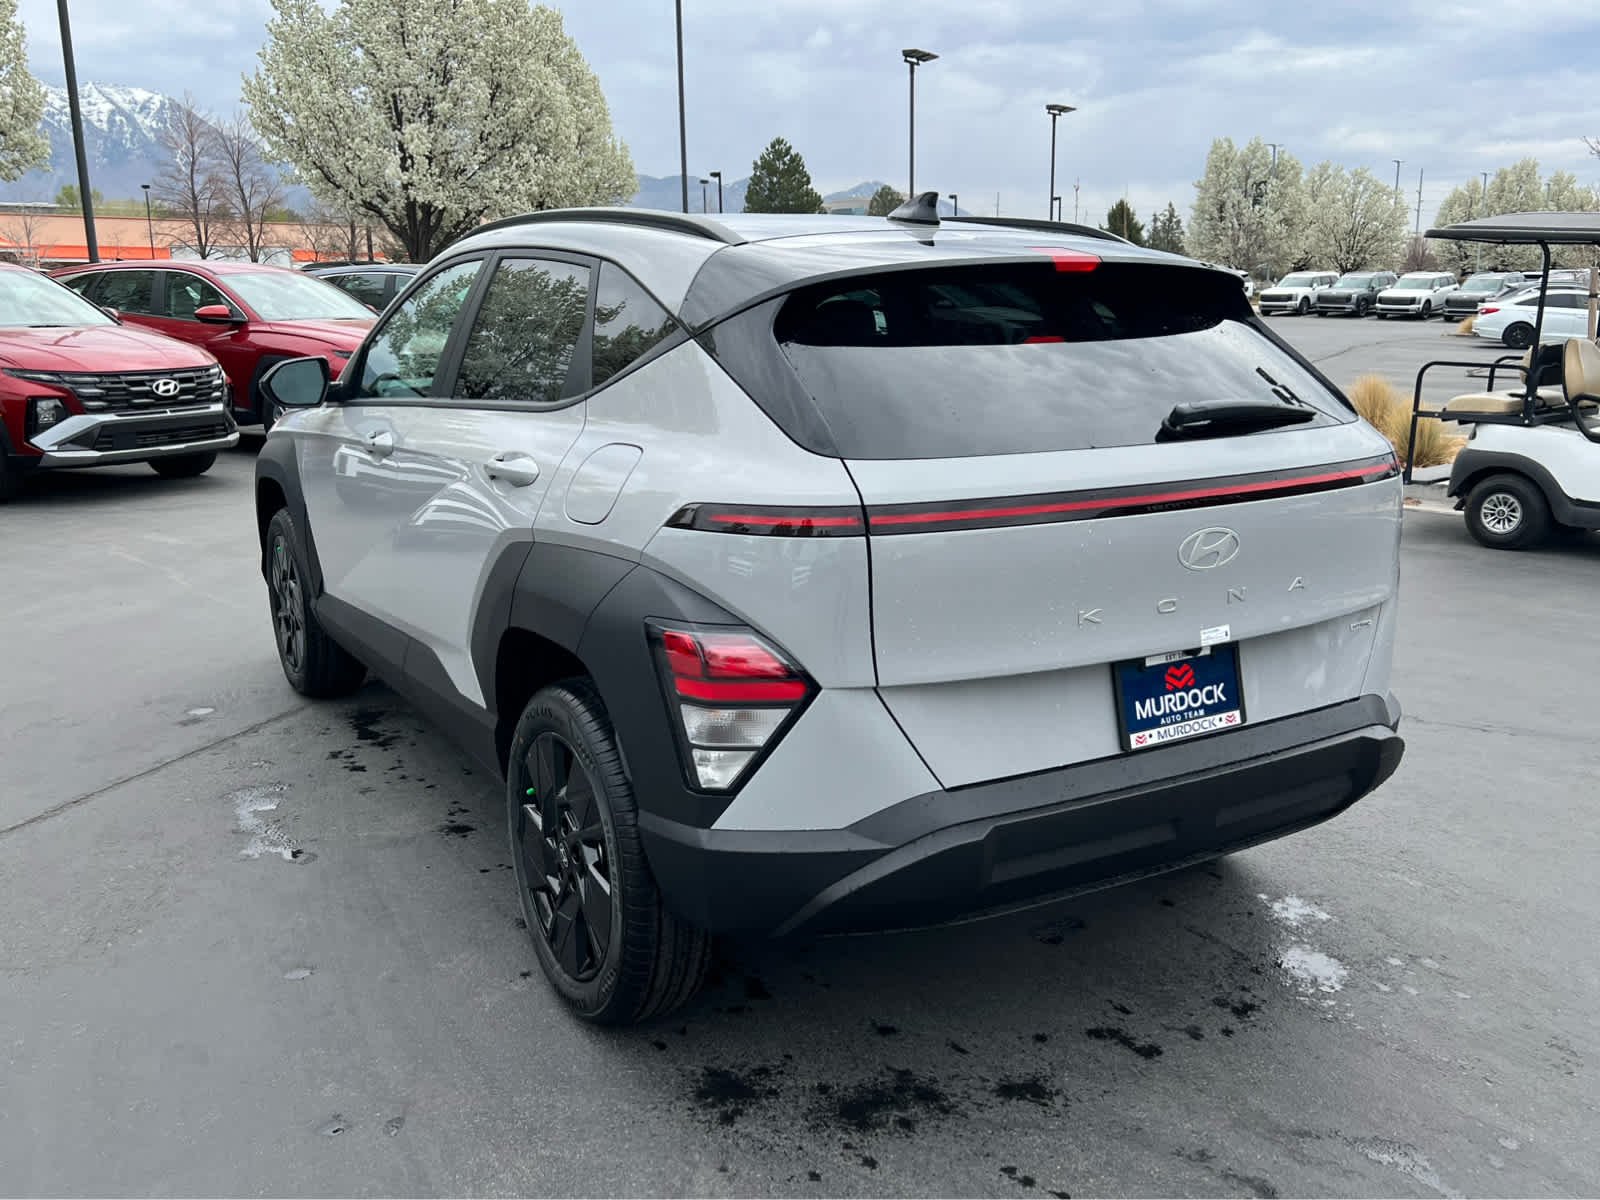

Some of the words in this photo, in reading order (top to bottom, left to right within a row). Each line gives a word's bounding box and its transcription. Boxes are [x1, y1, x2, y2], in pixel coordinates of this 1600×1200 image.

[1077, 576, 1305, 626] KONA
[1135, 682, 1226, 720] MURDOCK
[1157, 718, 1217, 740] MURDOCK
[1160, 717, 1181, 725] AUTO
[1183, 709, 1205, 719] TEAM
